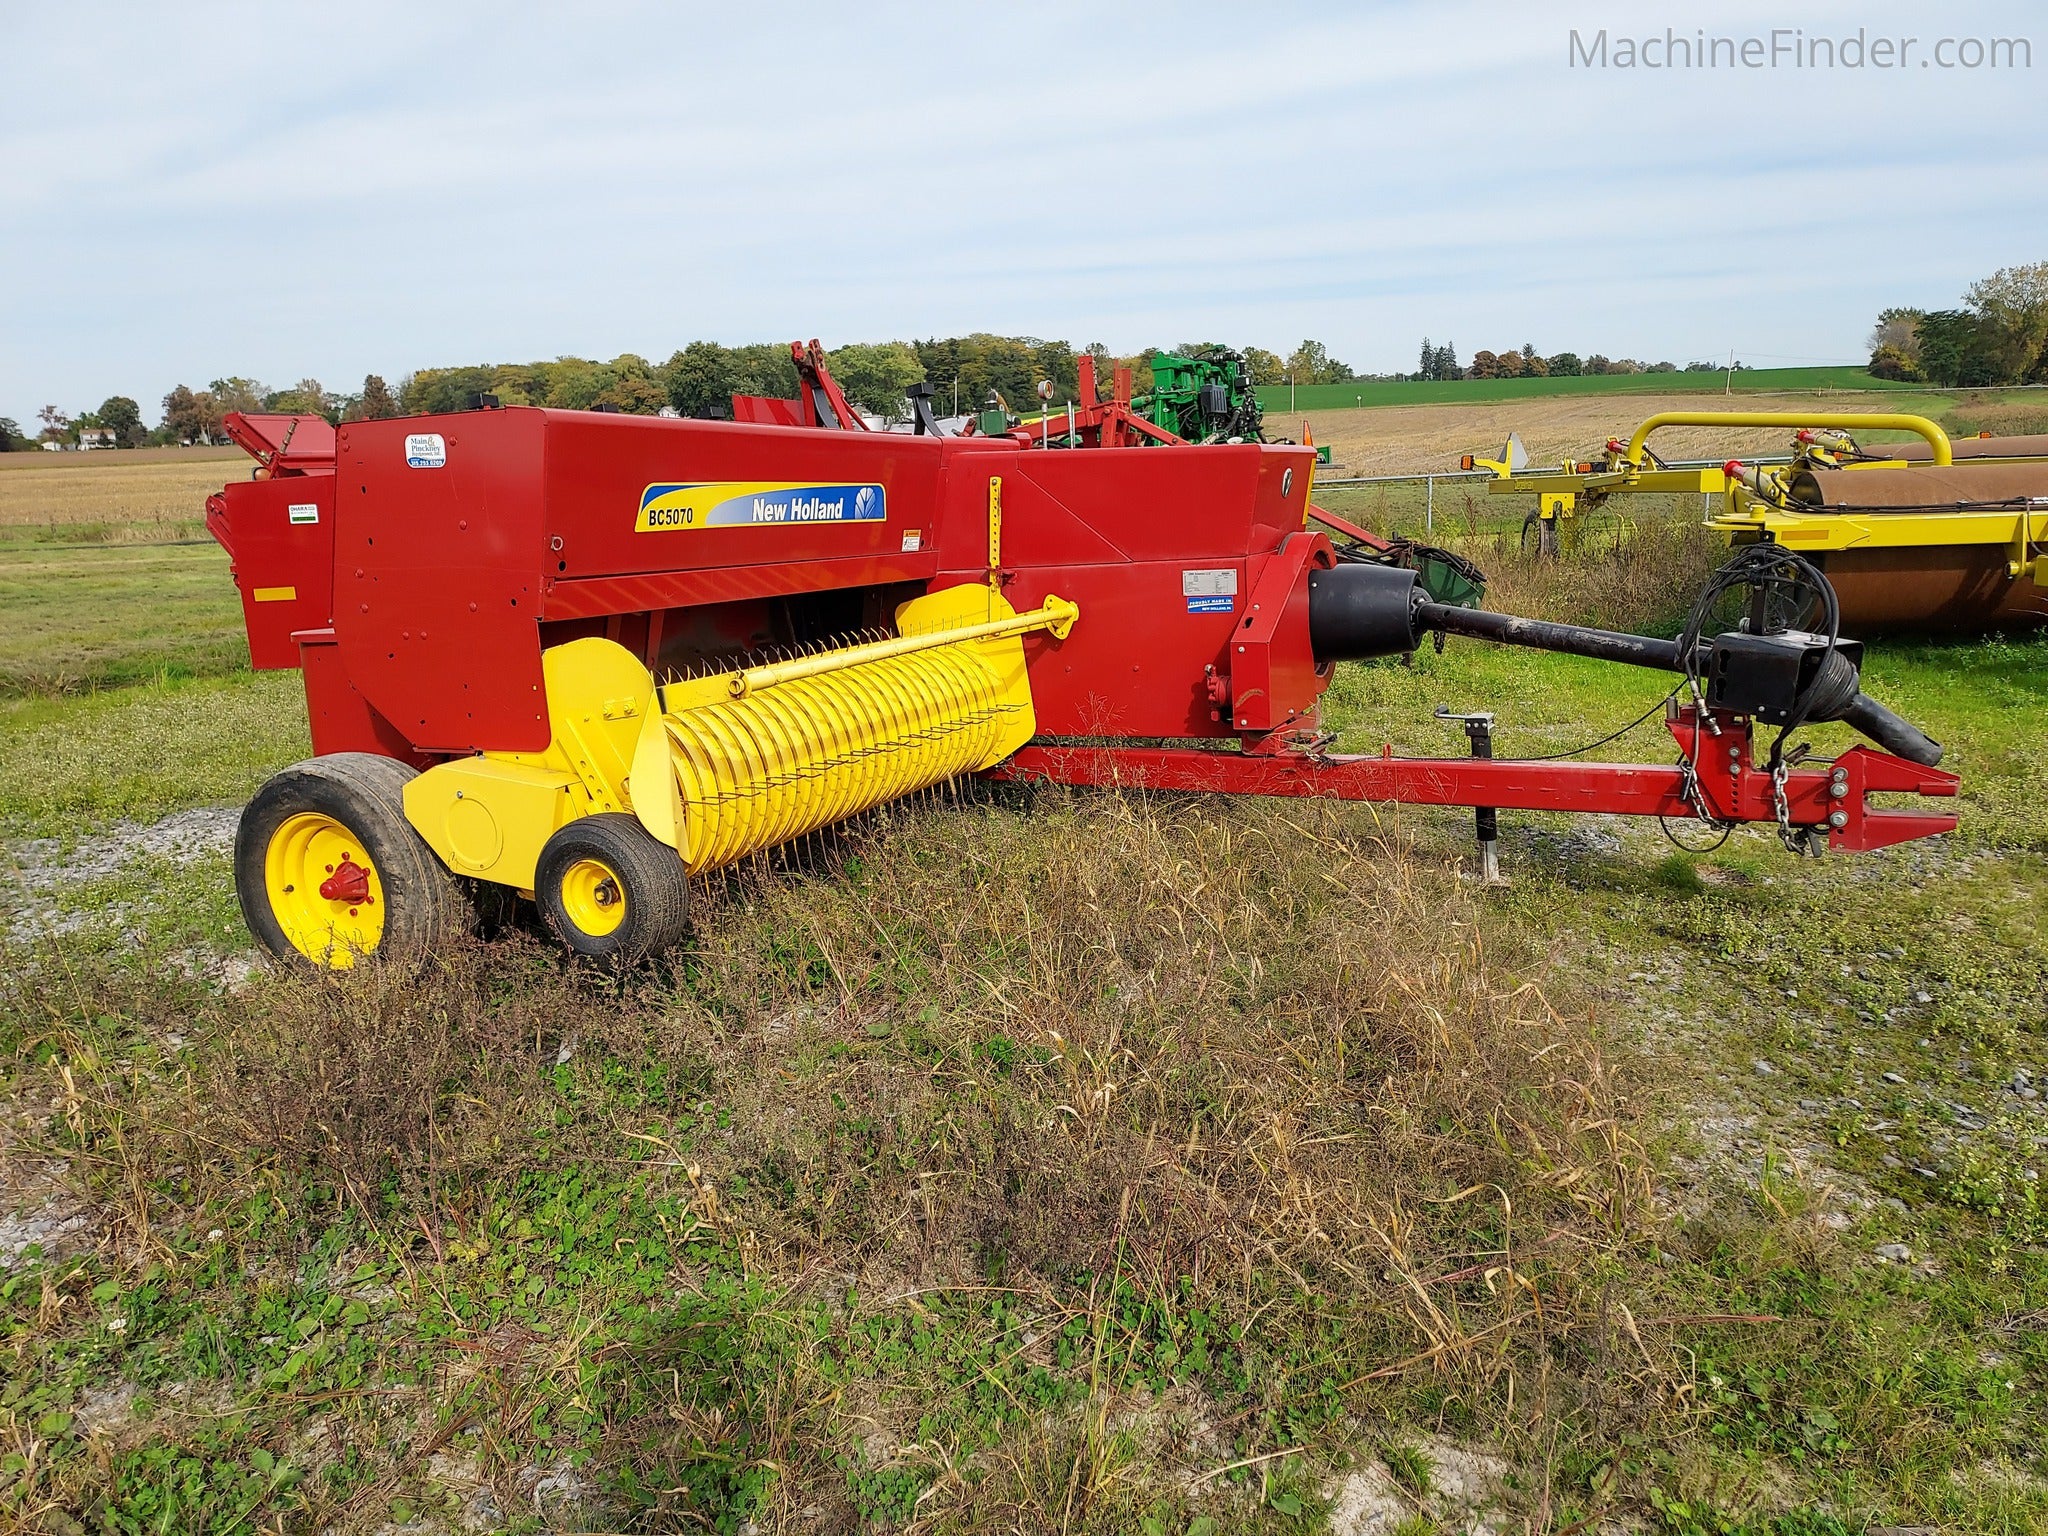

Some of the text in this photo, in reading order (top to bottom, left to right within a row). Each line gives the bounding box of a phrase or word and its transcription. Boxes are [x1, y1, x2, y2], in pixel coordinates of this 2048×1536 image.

[410, 437, 427, 445] Main
[411, 444, 440, 453] Pinckney
[752, 497, 844, 521] New Holland
[648, 507, 693, 526] BC5070
